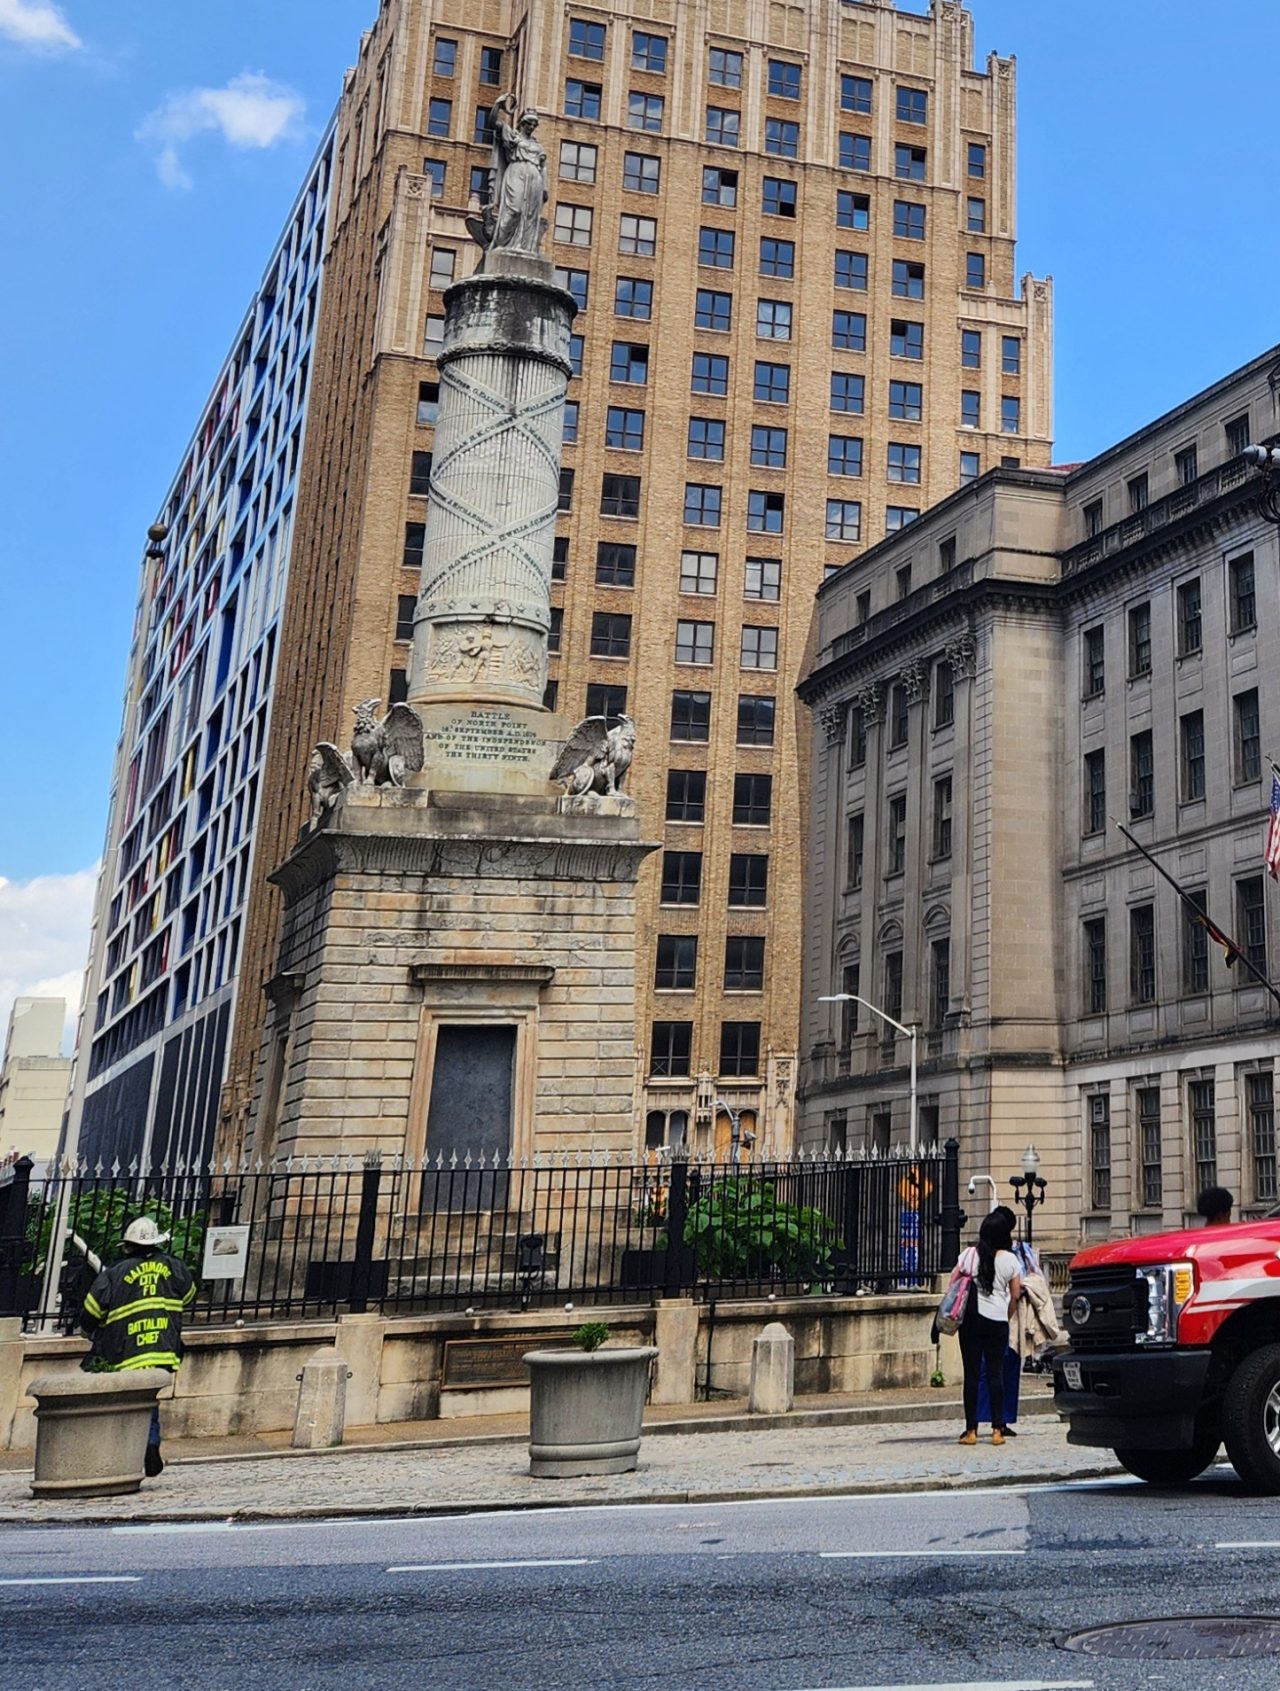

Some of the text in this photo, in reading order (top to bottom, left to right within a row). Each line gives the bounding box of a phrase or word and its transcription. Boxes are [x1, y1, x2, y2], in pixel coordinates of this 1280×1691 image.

[471, 711, 510, 720] BATTLE
[455, 727, 504, 736] SEPTEMBER
[466, 752, 500, 760] THIRTY
[124, 1261, 172, 1285] BALTIMORE
[139, 1273, 160, 1286] CITY
[143, 1284, 156, 1296] FD
[128, 1317, 168, 1335] BATTALION
[137, 1331, 160, 1347] CHIEF
